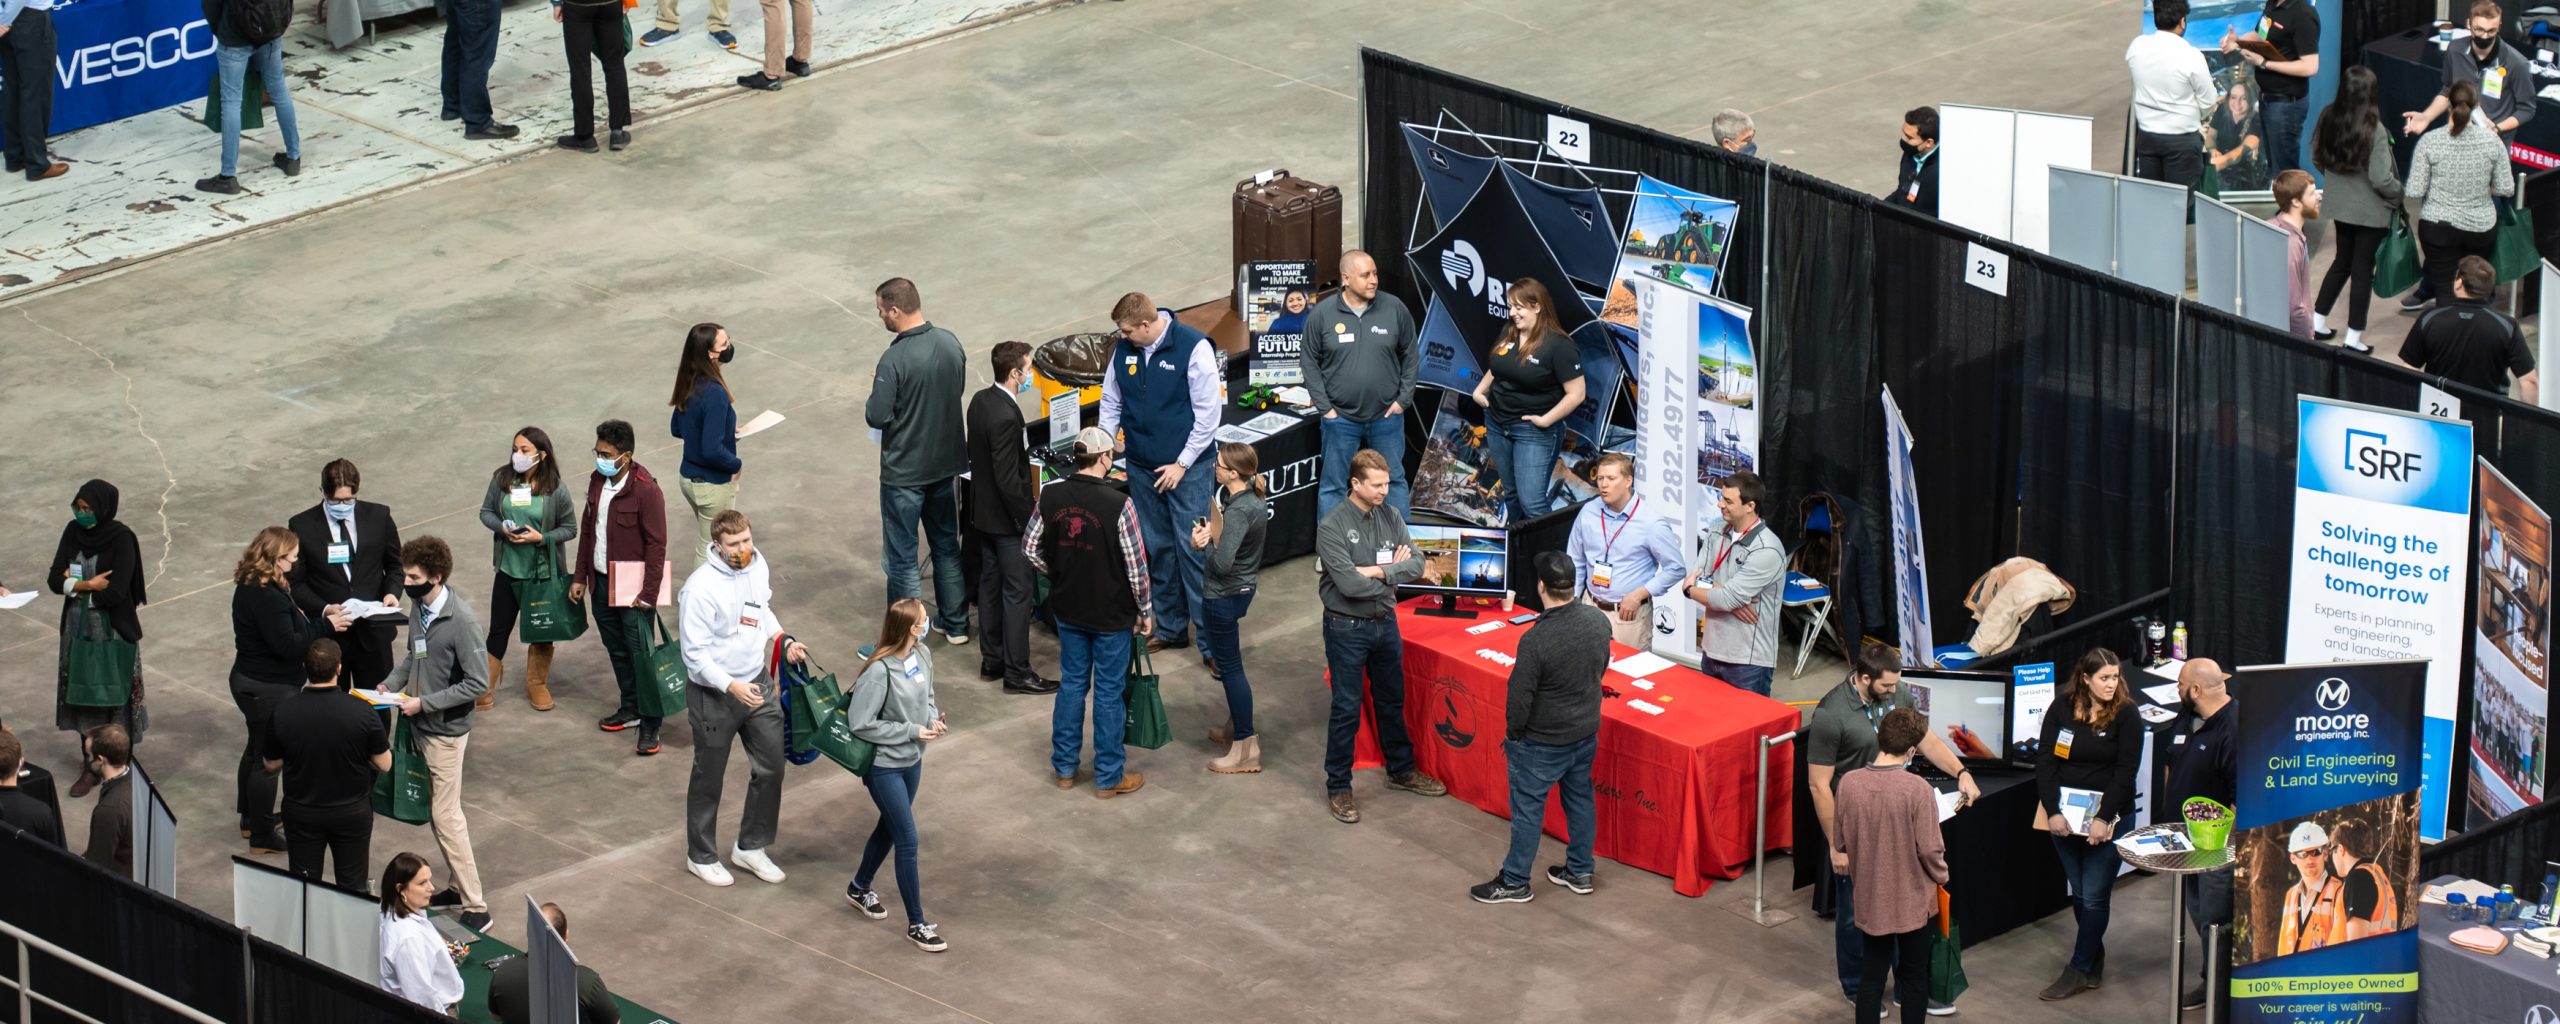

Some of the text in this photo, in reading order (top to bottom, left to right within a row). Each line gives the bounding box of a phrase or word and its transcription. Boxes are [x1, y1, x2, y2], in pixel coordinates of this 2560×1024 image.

[1559, 131, 1578, 147] 22
[1976, 260, 1996, 279] 23
[1270, 276, 1309, 285] IMPACT.
[1639, 284, 1655, 339] Inc.
[1258, 334, 1285, 342] ACCESS
[1258, 341, 1301, 353] FUTUR
[1425, 341, 1455, 360] RDO
[2430, 402, 2449, 417] 24
[1662, 367, 1685, 504] 282.4977
[2359, 446, 2422, 483] SRF
[2321, 521, 2438, 554] Solving the
[1895, 489, 1911, 631] 282.4977
[2308, 546, 2450, 582] challenges of
[2325, 573, 2429, 605] tomorrow
[2315, 603, 2435, 636] Experts in planning,
[2324, 638, 2349, 651] and
[2334, 625, 2413, 648] engineering,
[2037, 666, 2051, 674] Help
[2295, 713, 2369, 732] moore
[2295, 730, 2352, 743] engineering,
[2268, 752, 2396, 770] Civil Engineering
[2264, 770, 2399, 788] & Land Surveying
[2248, 978, 2405, 993] 100% Employee Owned
[2259, 1000, 2391, 1014] Your career is waiting...
